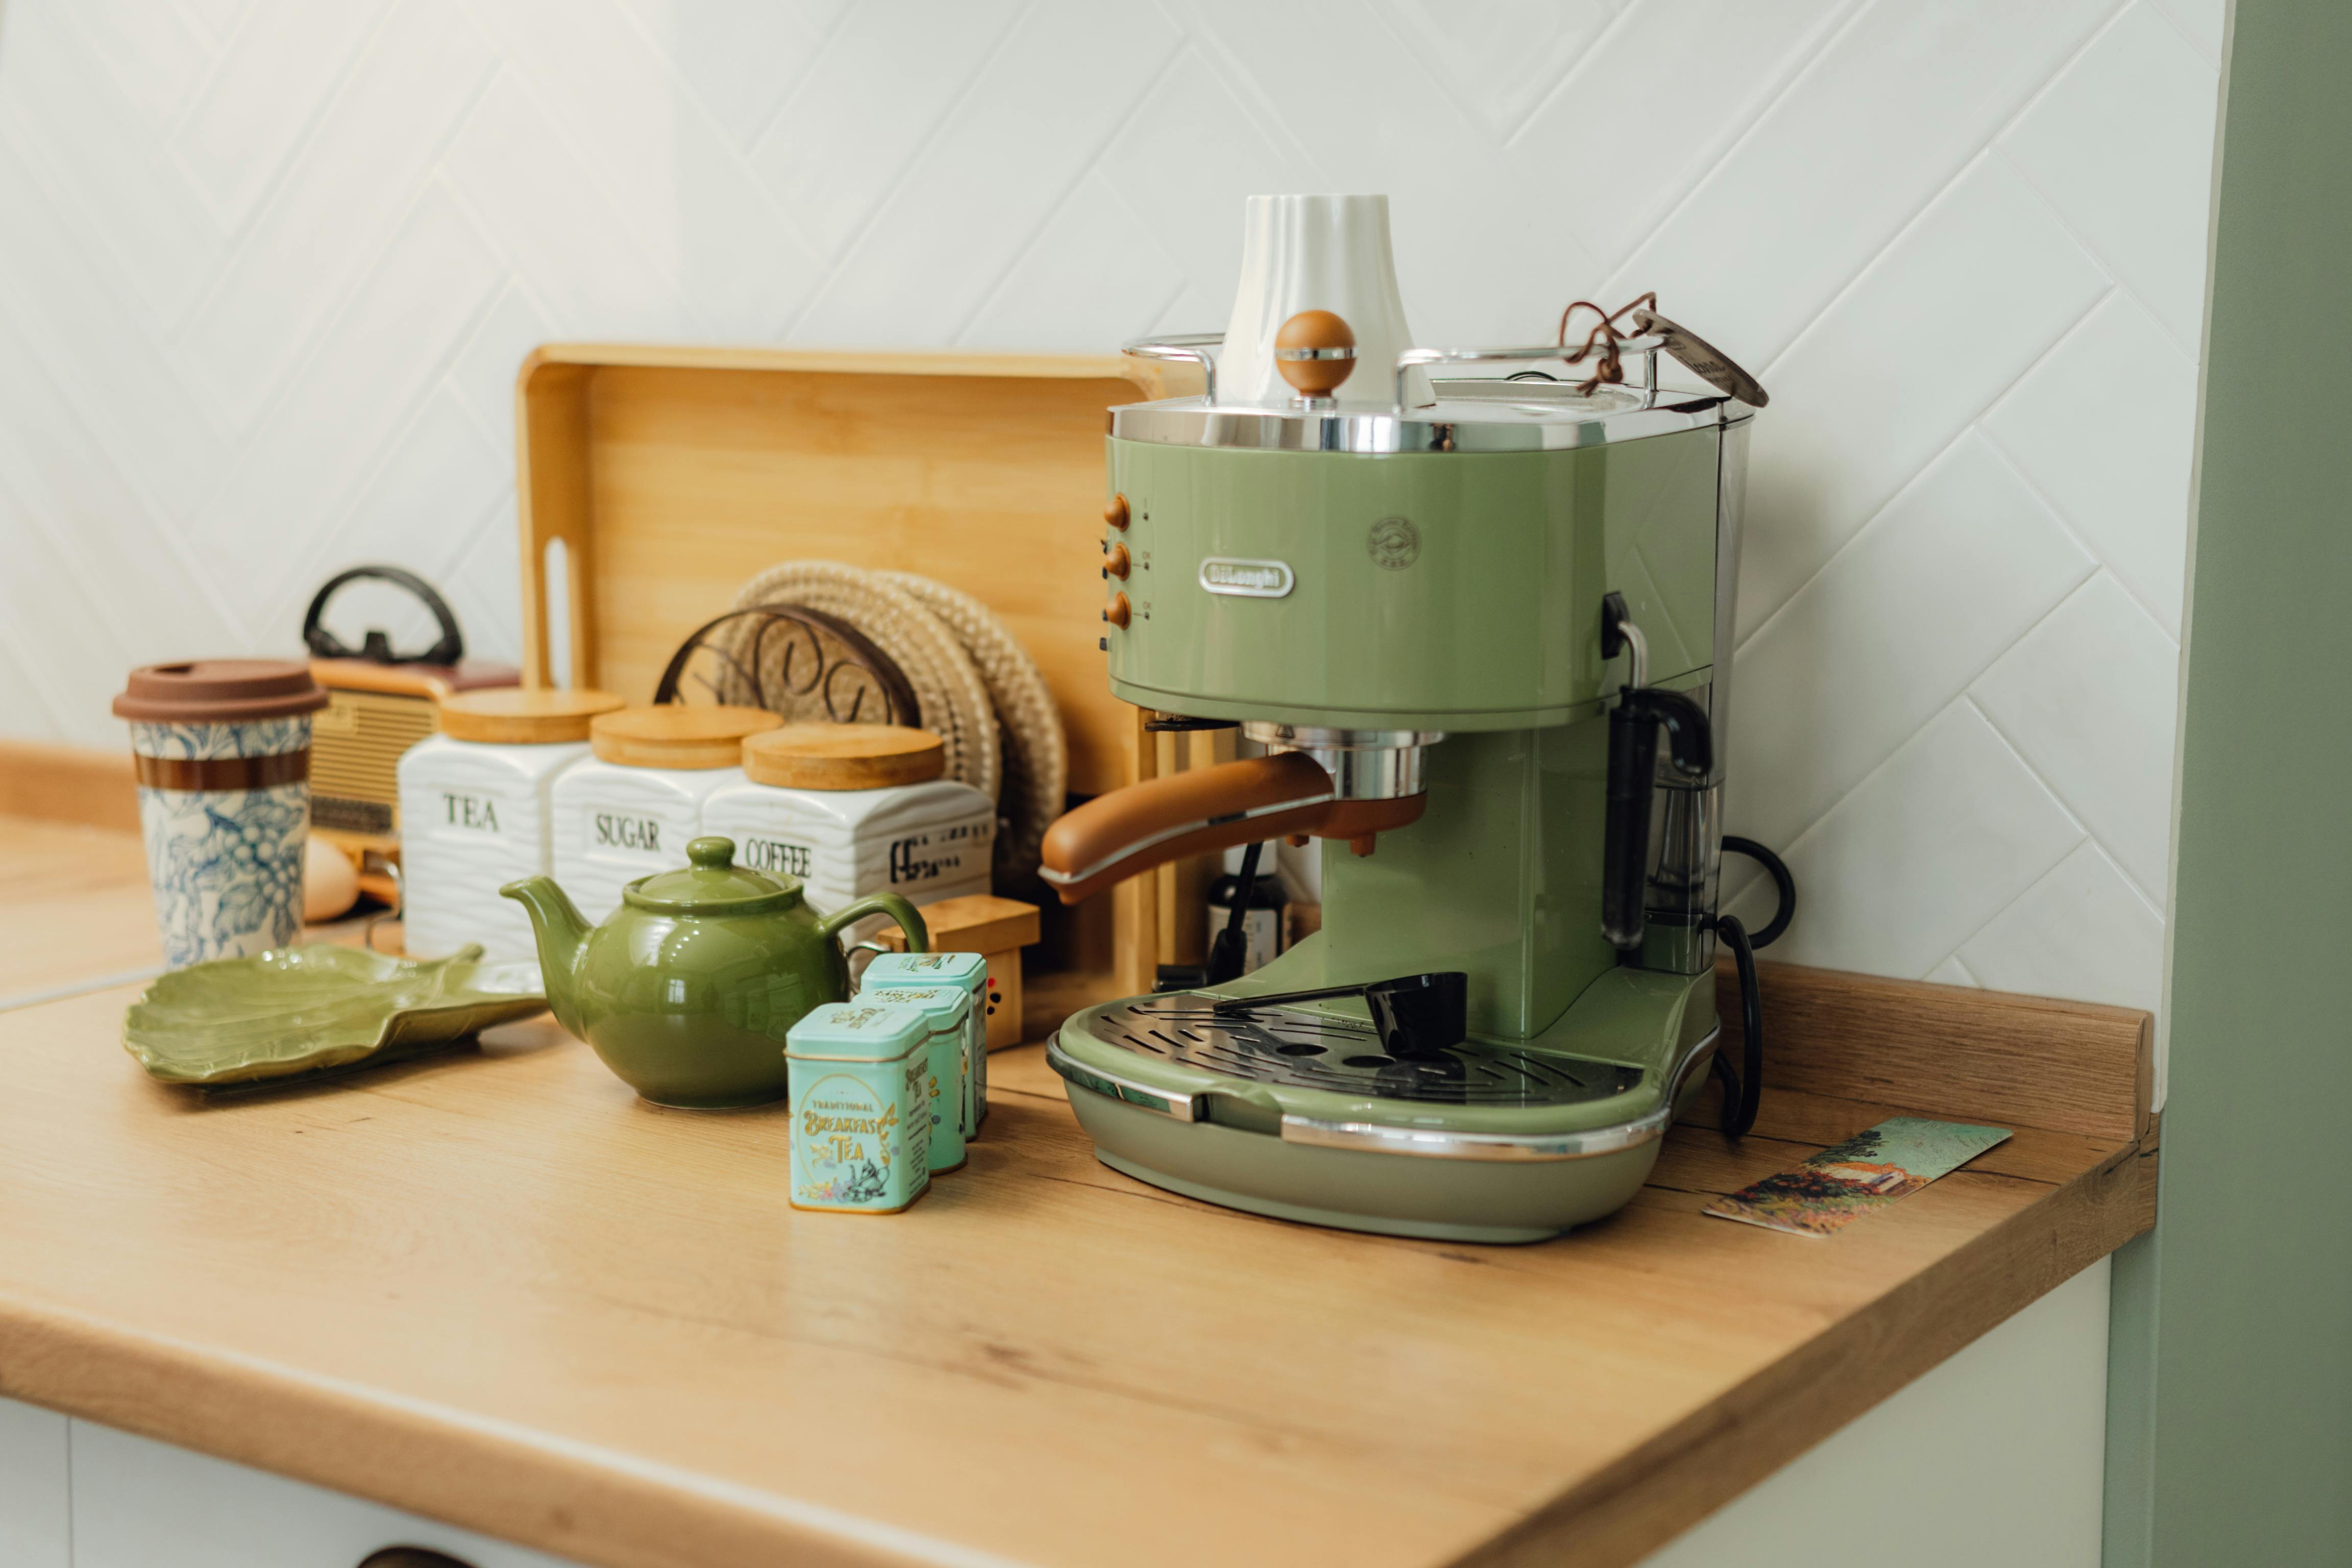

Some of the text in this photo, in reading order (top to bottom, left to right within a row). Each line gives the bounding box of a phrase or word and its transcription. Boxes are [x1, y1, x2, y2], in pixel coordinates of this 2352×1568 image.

[444, 793, 499, 833] TEA
[596, 814, 660, 851] SUGAR
[746, 838, 812, 878] COFFEE
[813, 1100, 873, 1112] TRADITIONAL
[804, 1110, 885, 1136] BREAKFAST
[828, 1135, 864, 1163] TEA
